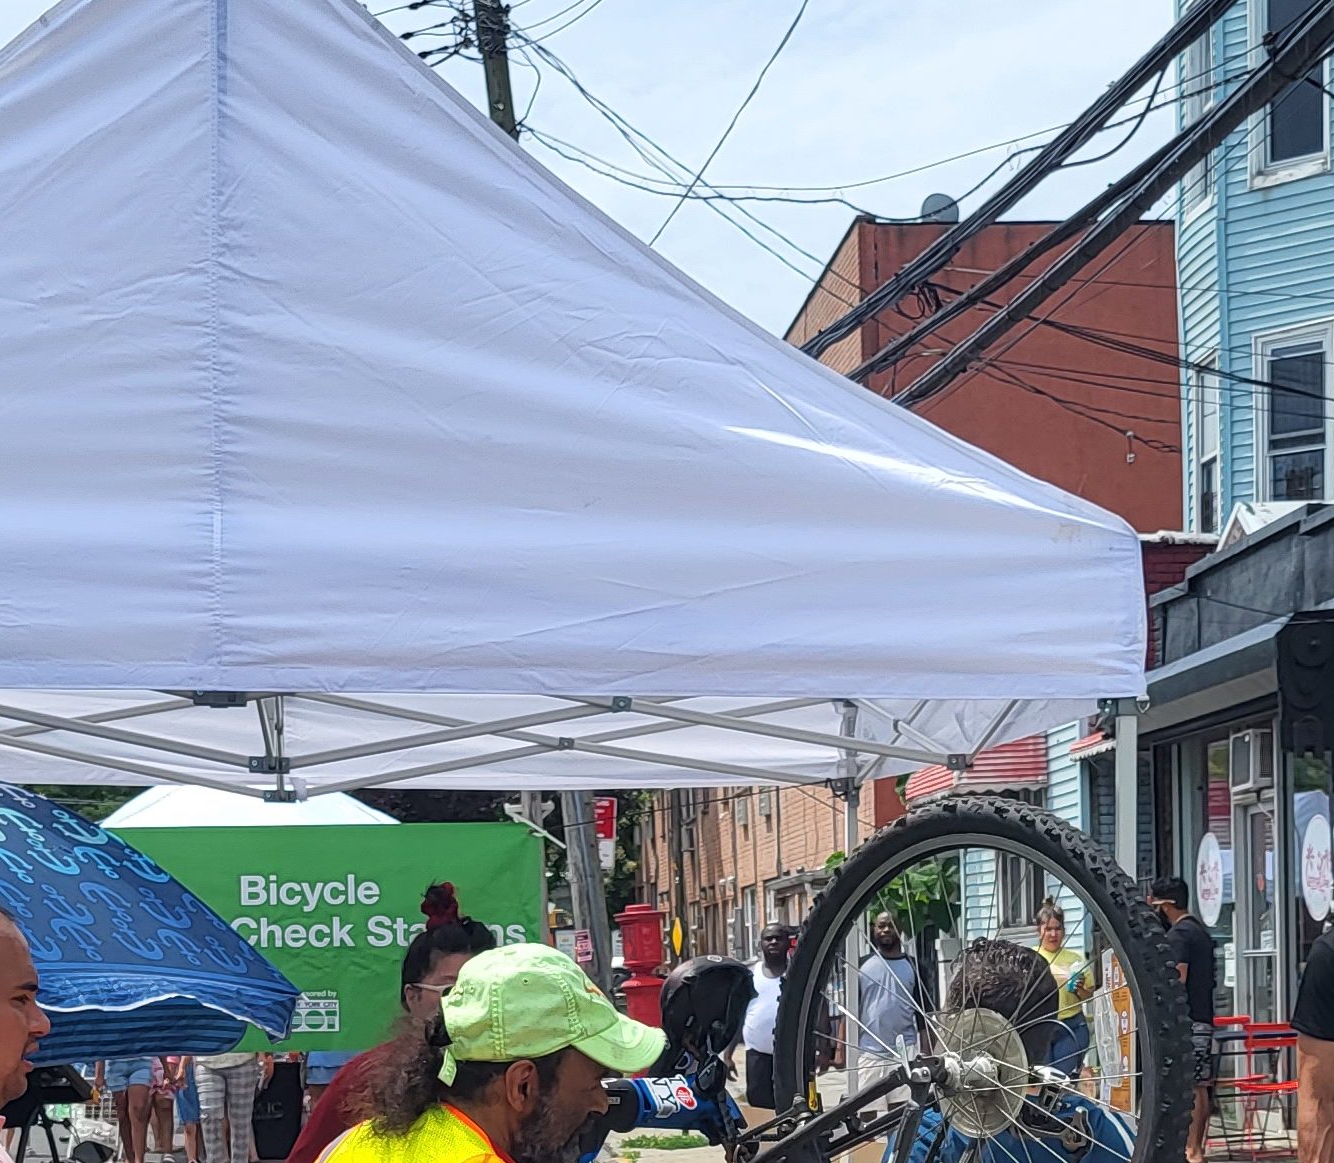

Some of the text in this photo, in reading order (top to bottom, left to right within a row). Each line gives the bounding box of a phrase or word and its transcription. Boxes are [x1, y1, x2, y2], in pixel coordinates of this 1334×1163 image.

[240, 874, 380, 912] Bicycle
[229, 916, 356, 948] Check
[366, 916, 527, 948] Stans
[328, 990, 338, 999] by
